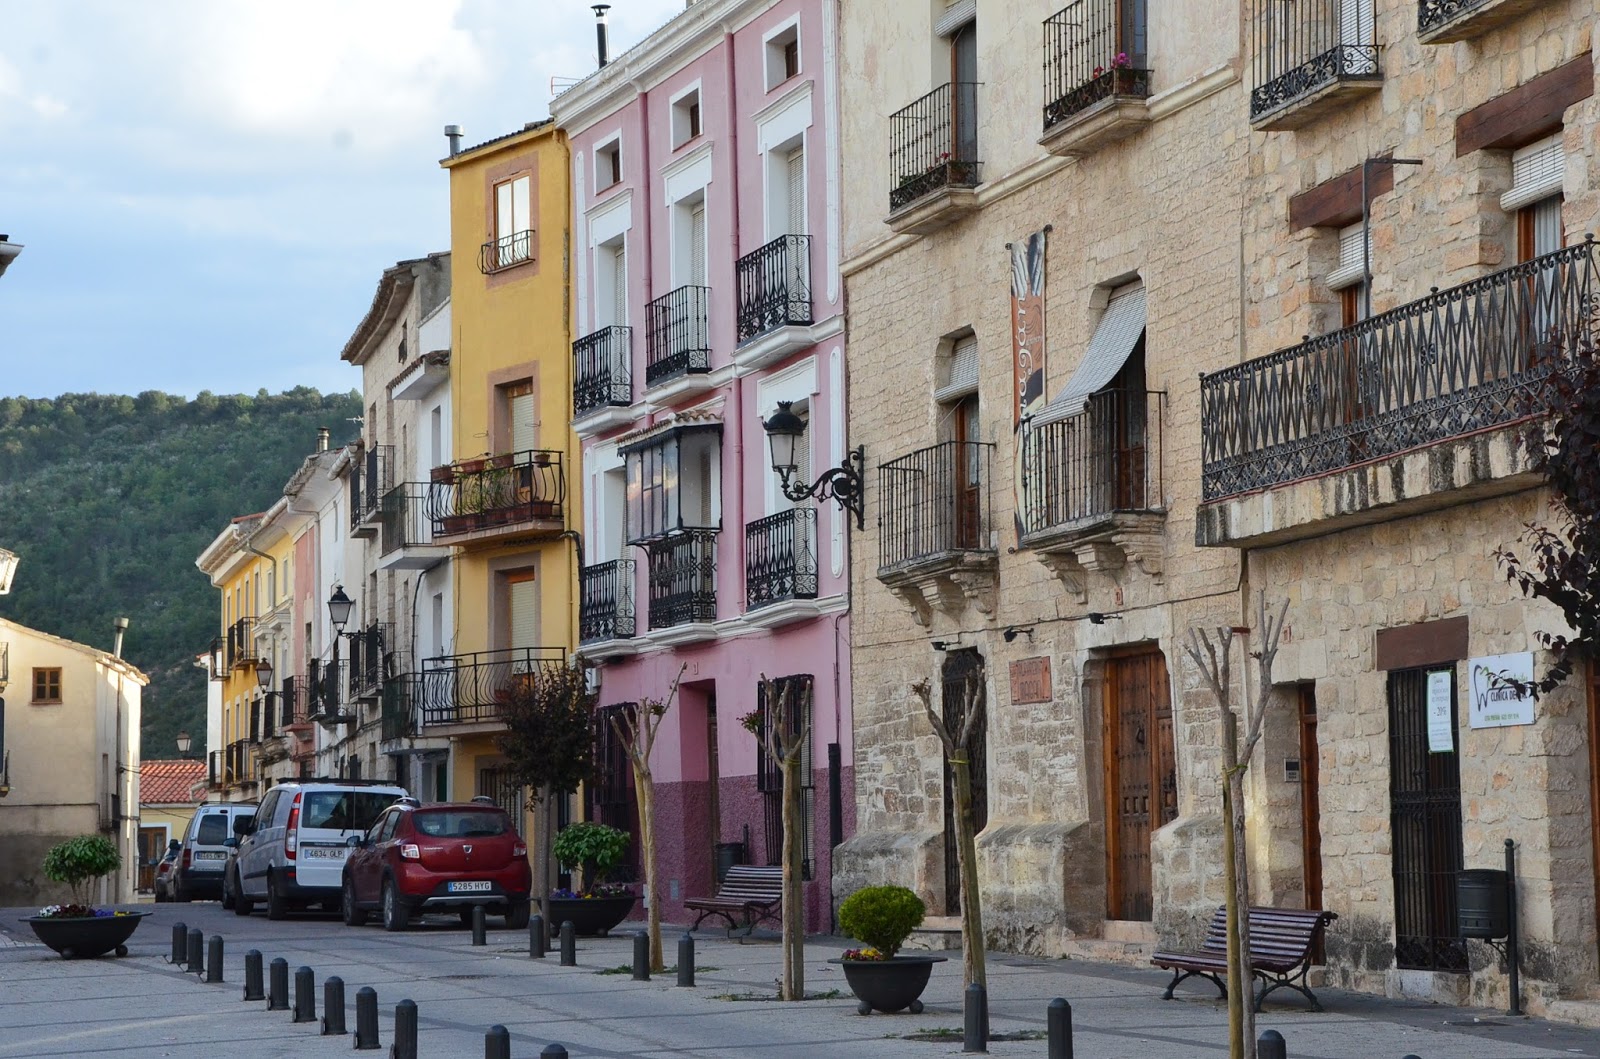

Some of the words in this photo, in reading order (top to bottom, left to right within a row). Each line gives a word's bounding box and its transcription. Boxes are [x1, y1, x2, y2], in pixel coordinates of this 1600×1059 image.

[310, 850, 326, 858] 4634
[329, 850, 343, 858] GLP
[453, 882, 473, 891] 5285
[474, 881, 490, 890] HYG
